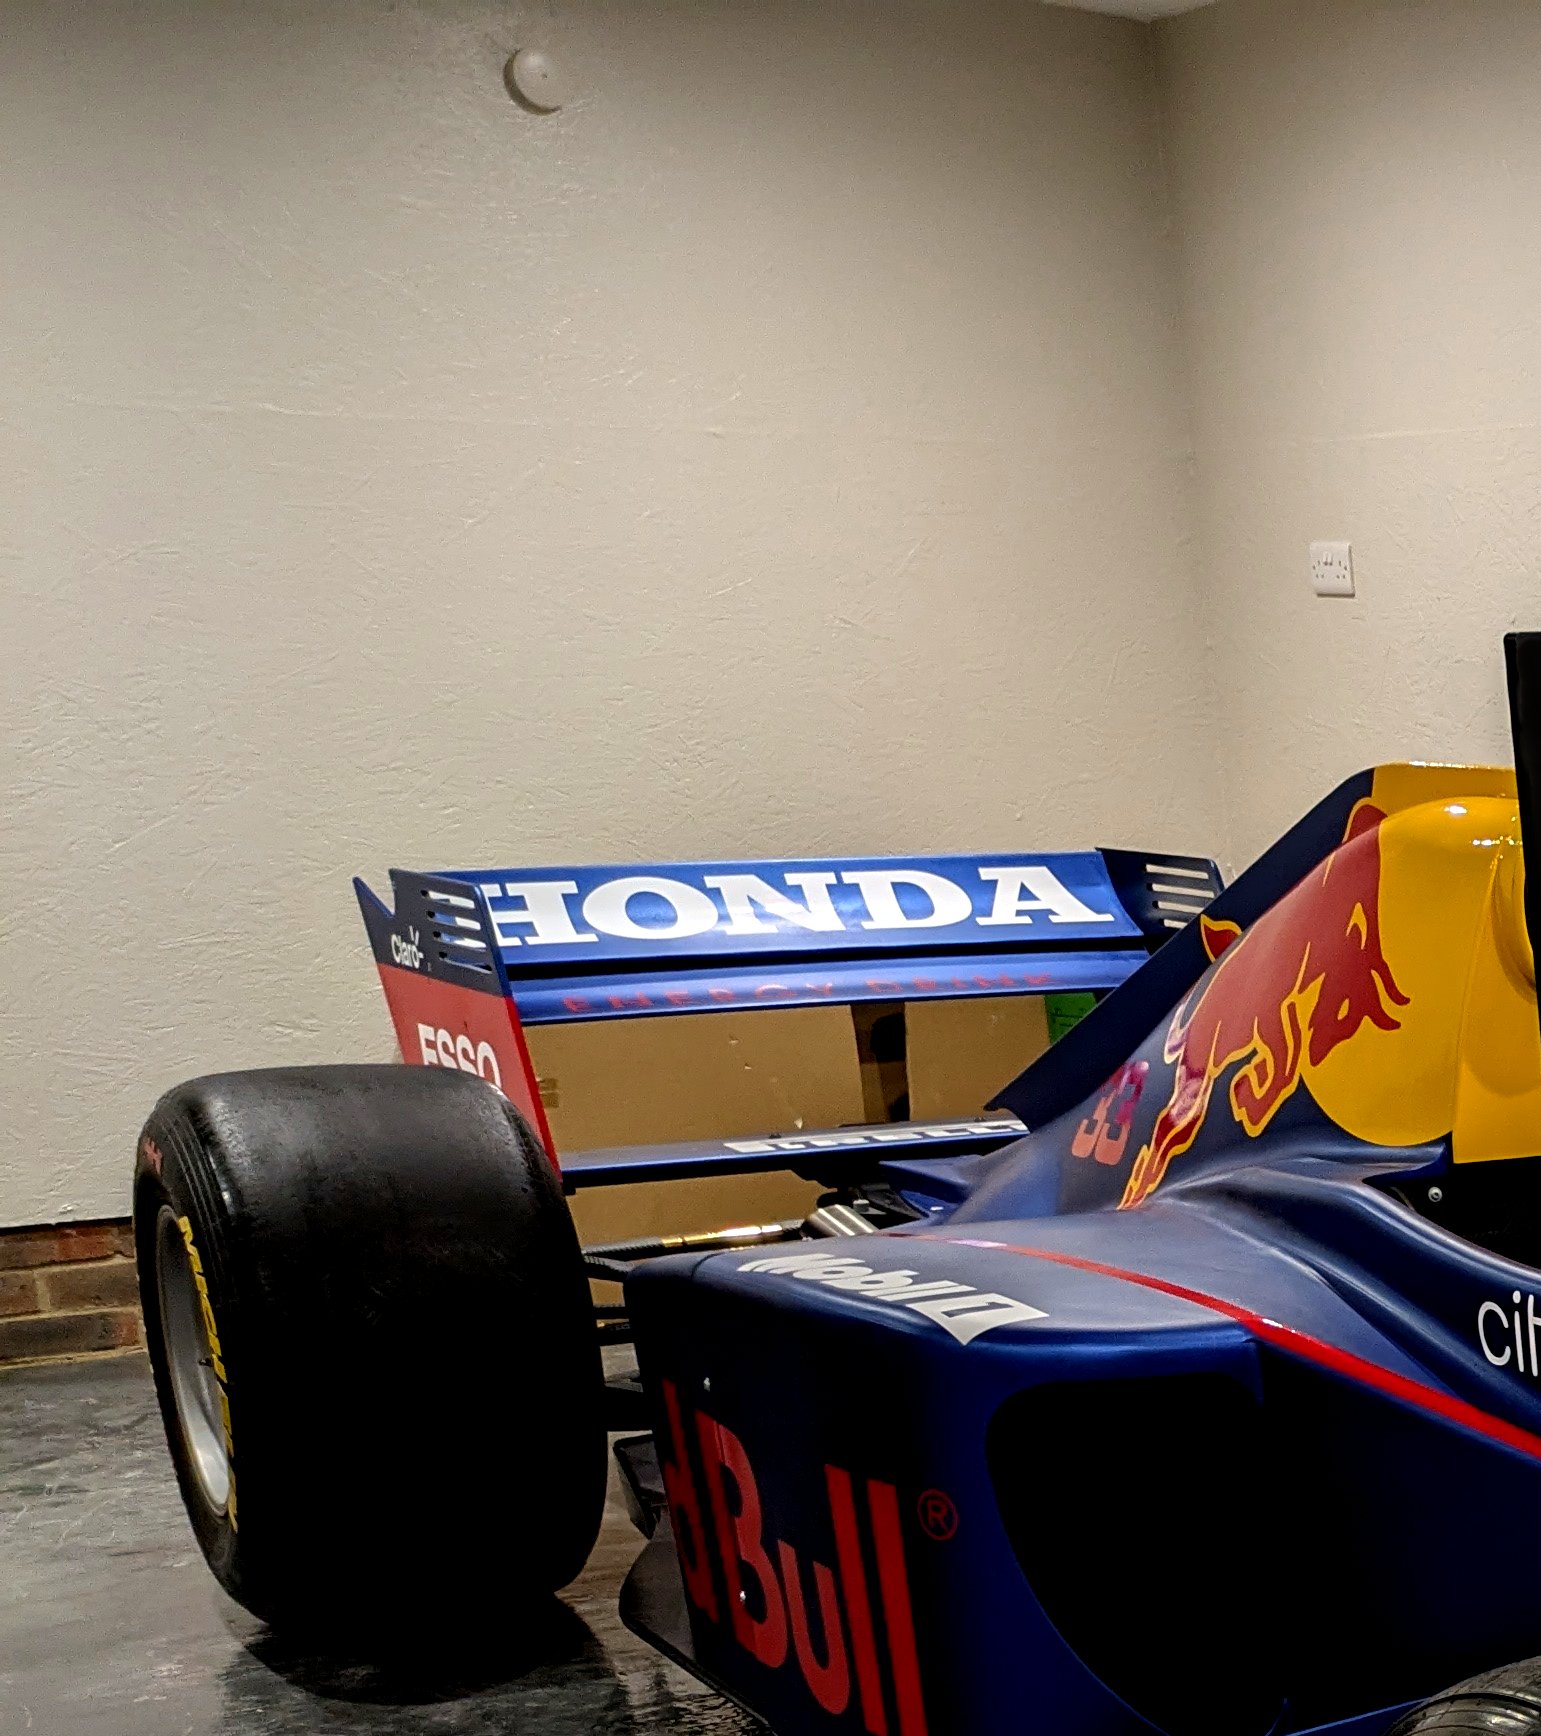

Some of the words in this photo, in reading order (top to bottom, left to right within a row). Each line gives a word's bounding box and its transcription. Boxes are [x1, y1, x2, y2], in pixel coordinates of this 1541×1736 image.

[486, 866, 1114, 946] HONDA
[391, 926, 424, 969] Claro
[1071, 1061, 1149, 1165] 33
[737, 1253, 977, 1301] Mobil
